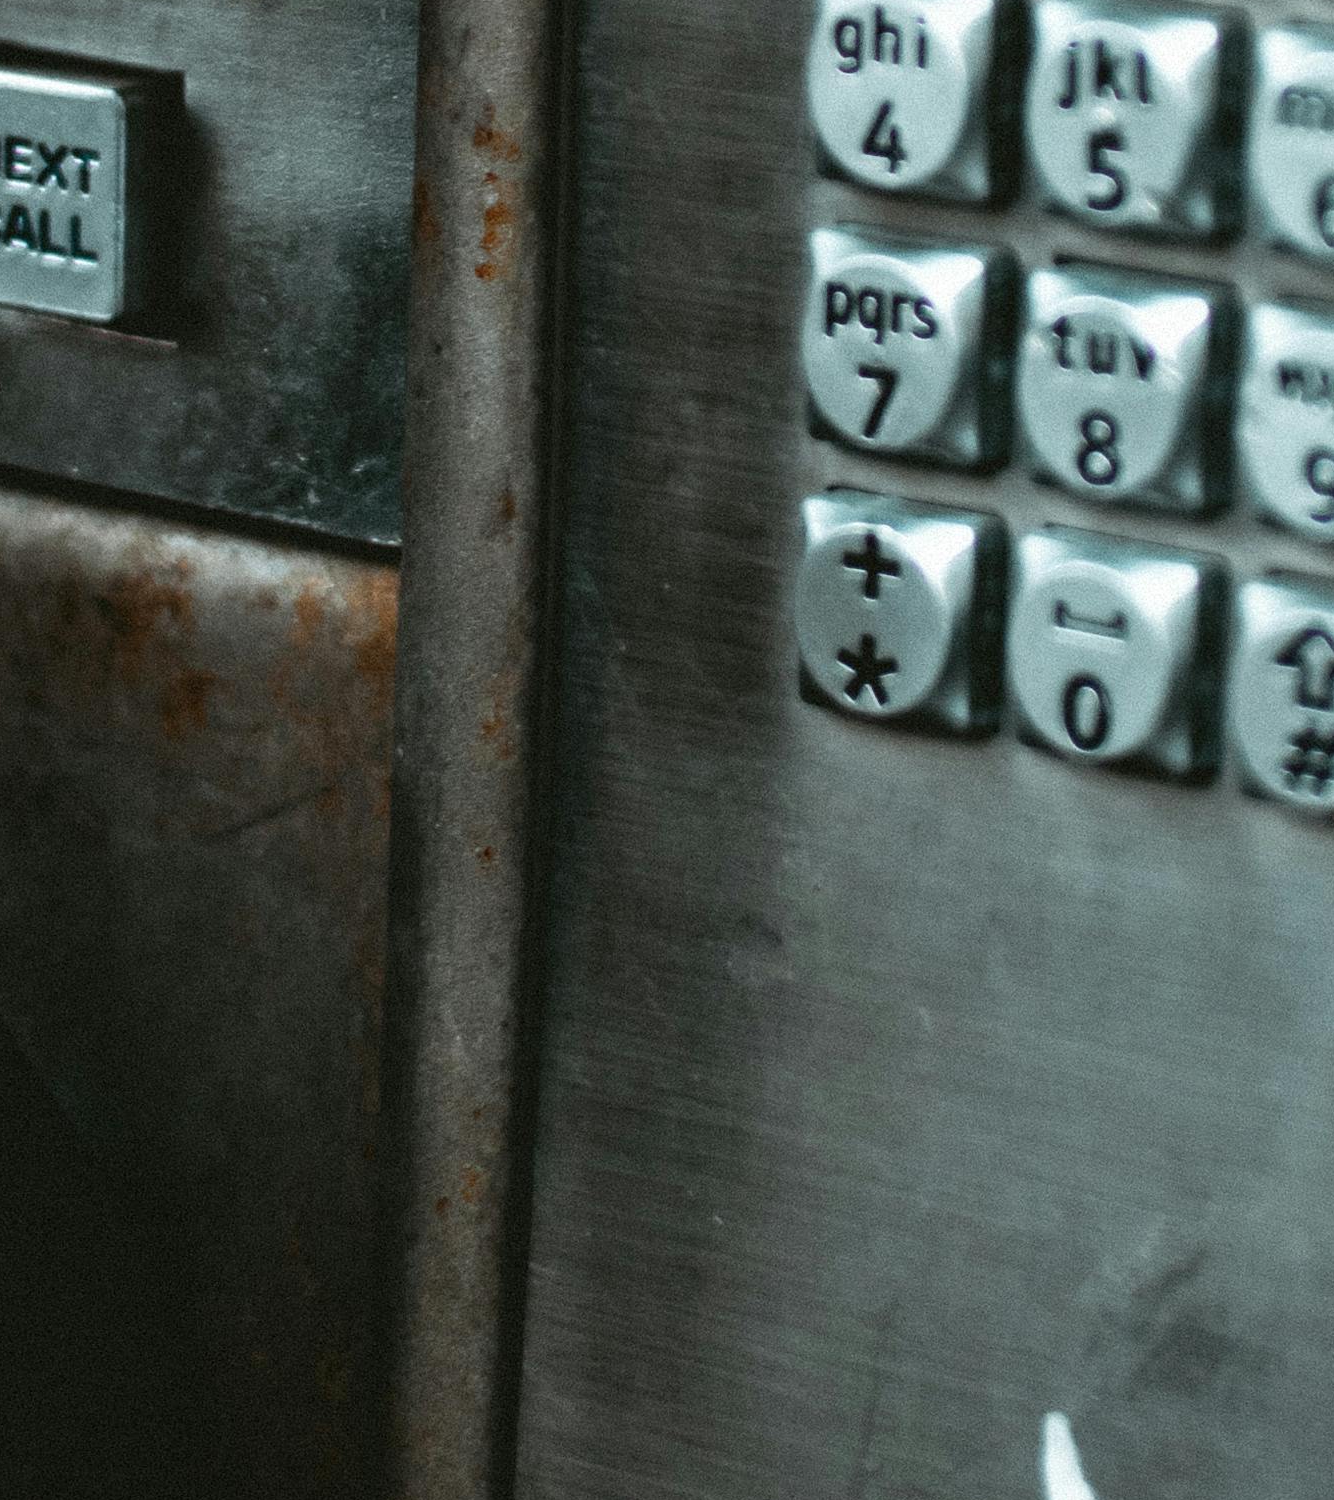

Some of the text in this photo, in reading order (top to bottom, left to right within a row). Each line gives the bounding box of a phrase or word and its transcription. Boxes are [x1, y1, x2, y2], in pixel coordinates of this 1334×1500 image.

[833, 5, 928, 74] ghi
[1058, 39, 1150, 109] jkl
[862, 100, 906, 174] 4
[1087, 131, 1125, 211] 5
[826, 281, 938, 344] pqrs
[1053, 316, 1156, 381] tuv
[857, 366, 899, 438] 7
[1076, 409, 1117, 485] 8
[1063, 673, 1110, 751] 0
